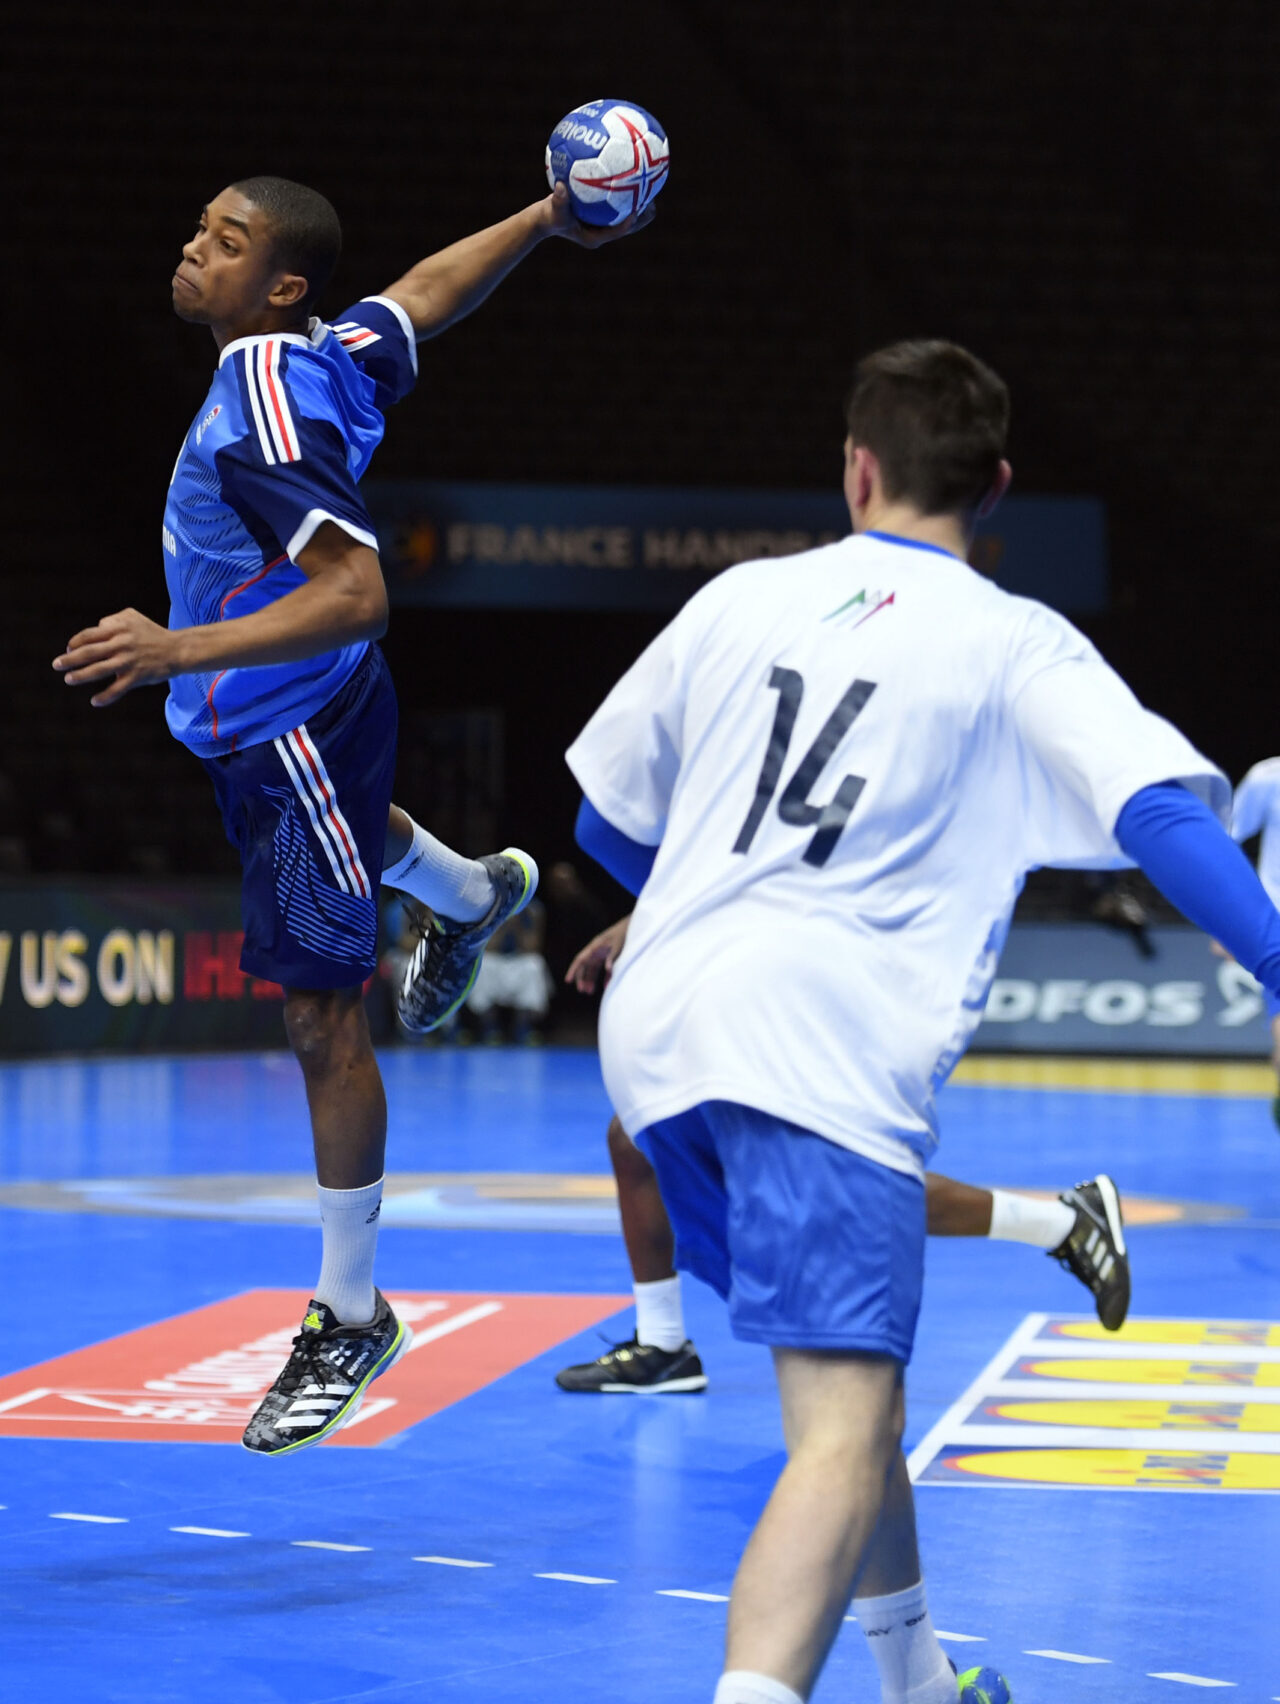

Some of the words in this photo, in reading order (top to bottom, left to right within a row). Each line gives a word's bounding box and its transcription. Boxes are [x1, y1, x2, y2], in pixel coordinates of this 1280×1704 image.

[446, 524, 633, 571] FRANCE
[731, 666, 878, 868] 14
[21, 929, 90, 1008] US
[97, 928, 176, 1007] ON
[983, 978, 1204, 1026] DFOS
